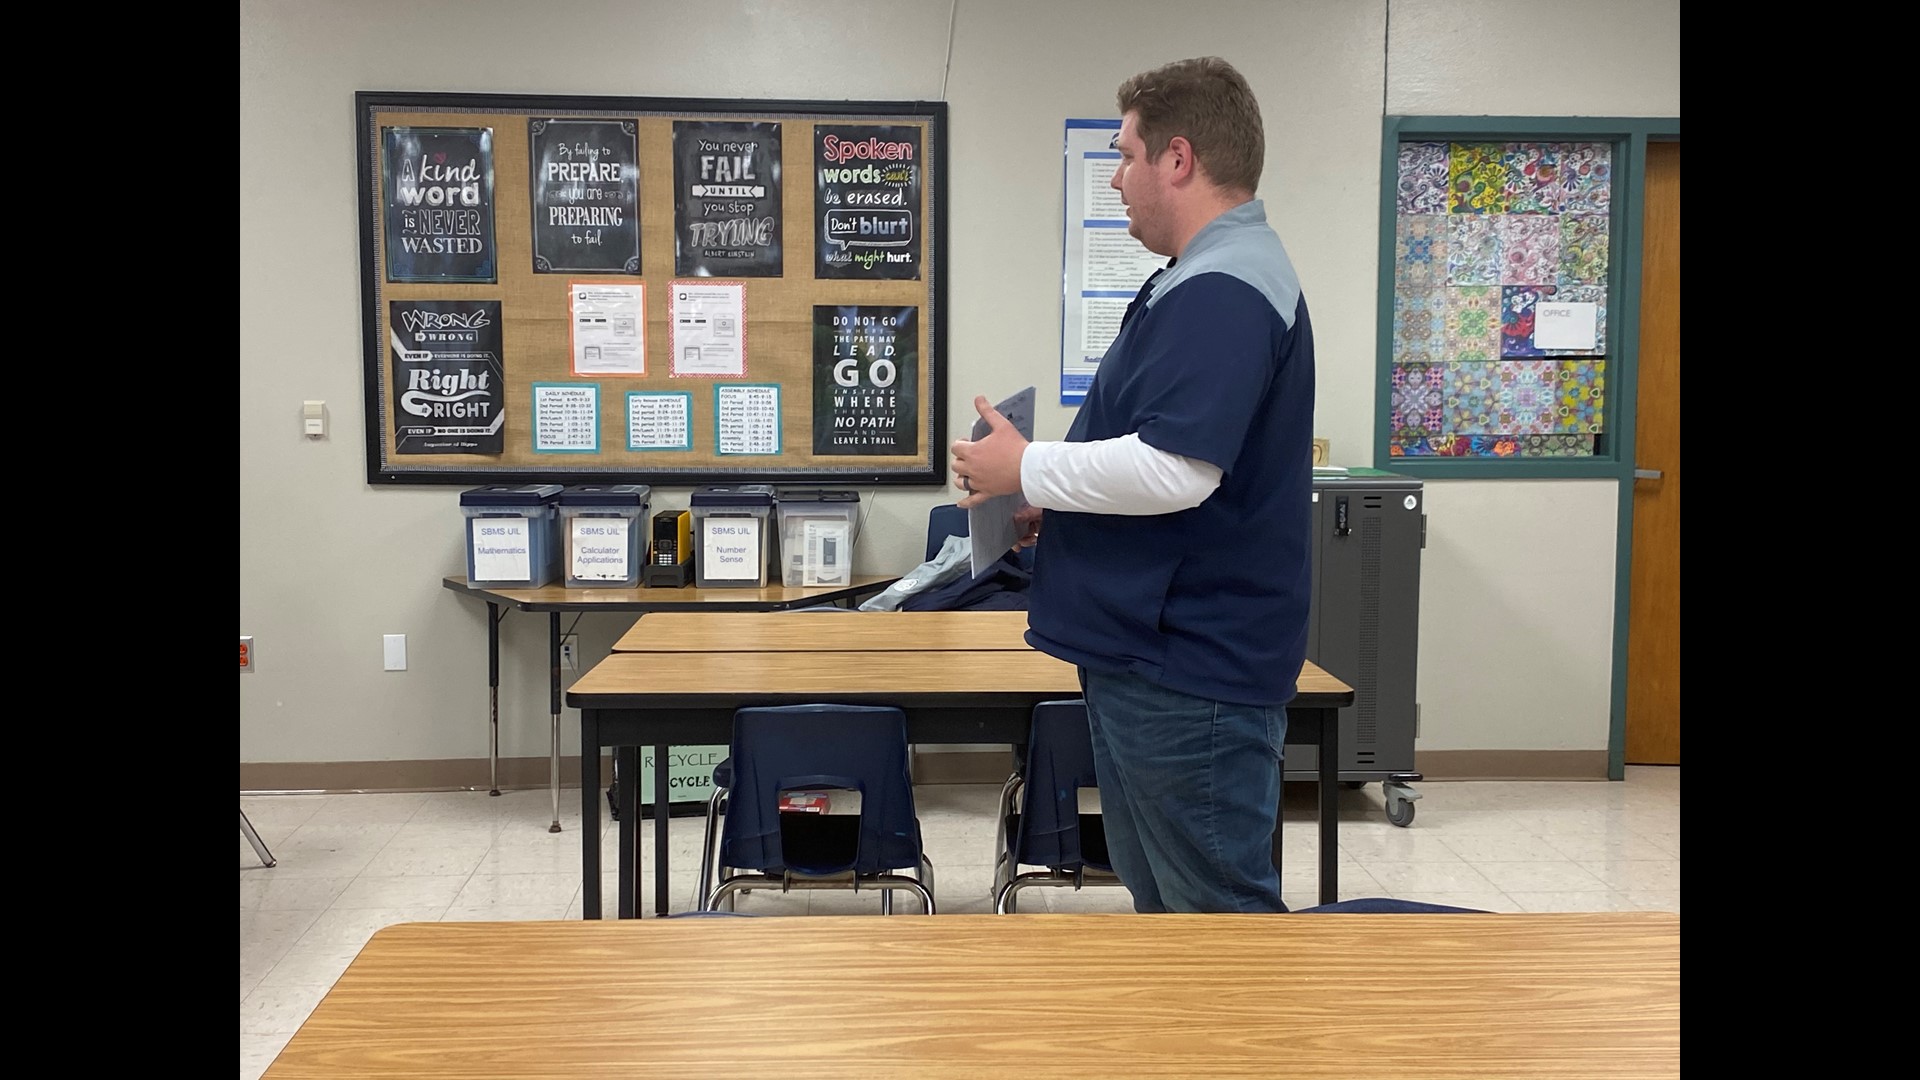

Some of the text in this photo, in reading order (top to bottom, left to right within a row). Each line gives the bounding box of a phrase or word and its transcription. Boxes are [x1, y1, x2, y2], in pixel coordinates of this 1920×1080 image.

[558, 142, 611, 161] By failing to
[698, 140, 758, 153] You never
[824, 134, 913, 164] Spoken
[401, 154, 481, 183] A kind
[700, 155, 756, 183] FAIL
[824, 164, 881, 184] words
[400, 182, 479, 207] word
[568, 188, 602, 205] you are
[710, 187, 746, 195] UNTIL
[824, 187, 908, 206] be erased.
[549, 206, 623, 227] PREPARING
[704, 200, 754, 216] you stop
[404, 209, 481, 235] is NEVER
[831, 216, 909, 235] Don't blurt
[571, 233, 582, 244] to
[689, 216, 775, 247] TRYING
[401, 237, 483, 254] WASTED
[854, 249, 885, 270] might
[886, 251, 913, 263] hurt.
[401, 309, 491, 333] WRONG
[833, 316, 897, 326] DO NOT GO
[428, 333, 474, 341] WRONG
[833, 345, 896, 356] LEAD.
[833, 358, 896, 388] GO
[407, 368, 490, 396] Right
[433, 402, 490, 418] RIGHT
[834, 396, 896, 408] WHERE
[835, 417, 896, 428] NO PATH
[481, 527, 506, 536] SBMS
[580, 527, 605, 536] SBMS
[577, 556, 623, 564] Applications
[644, 753, 720, 768] RCYCLE
[669, 775, 710, 788] CYCLE
